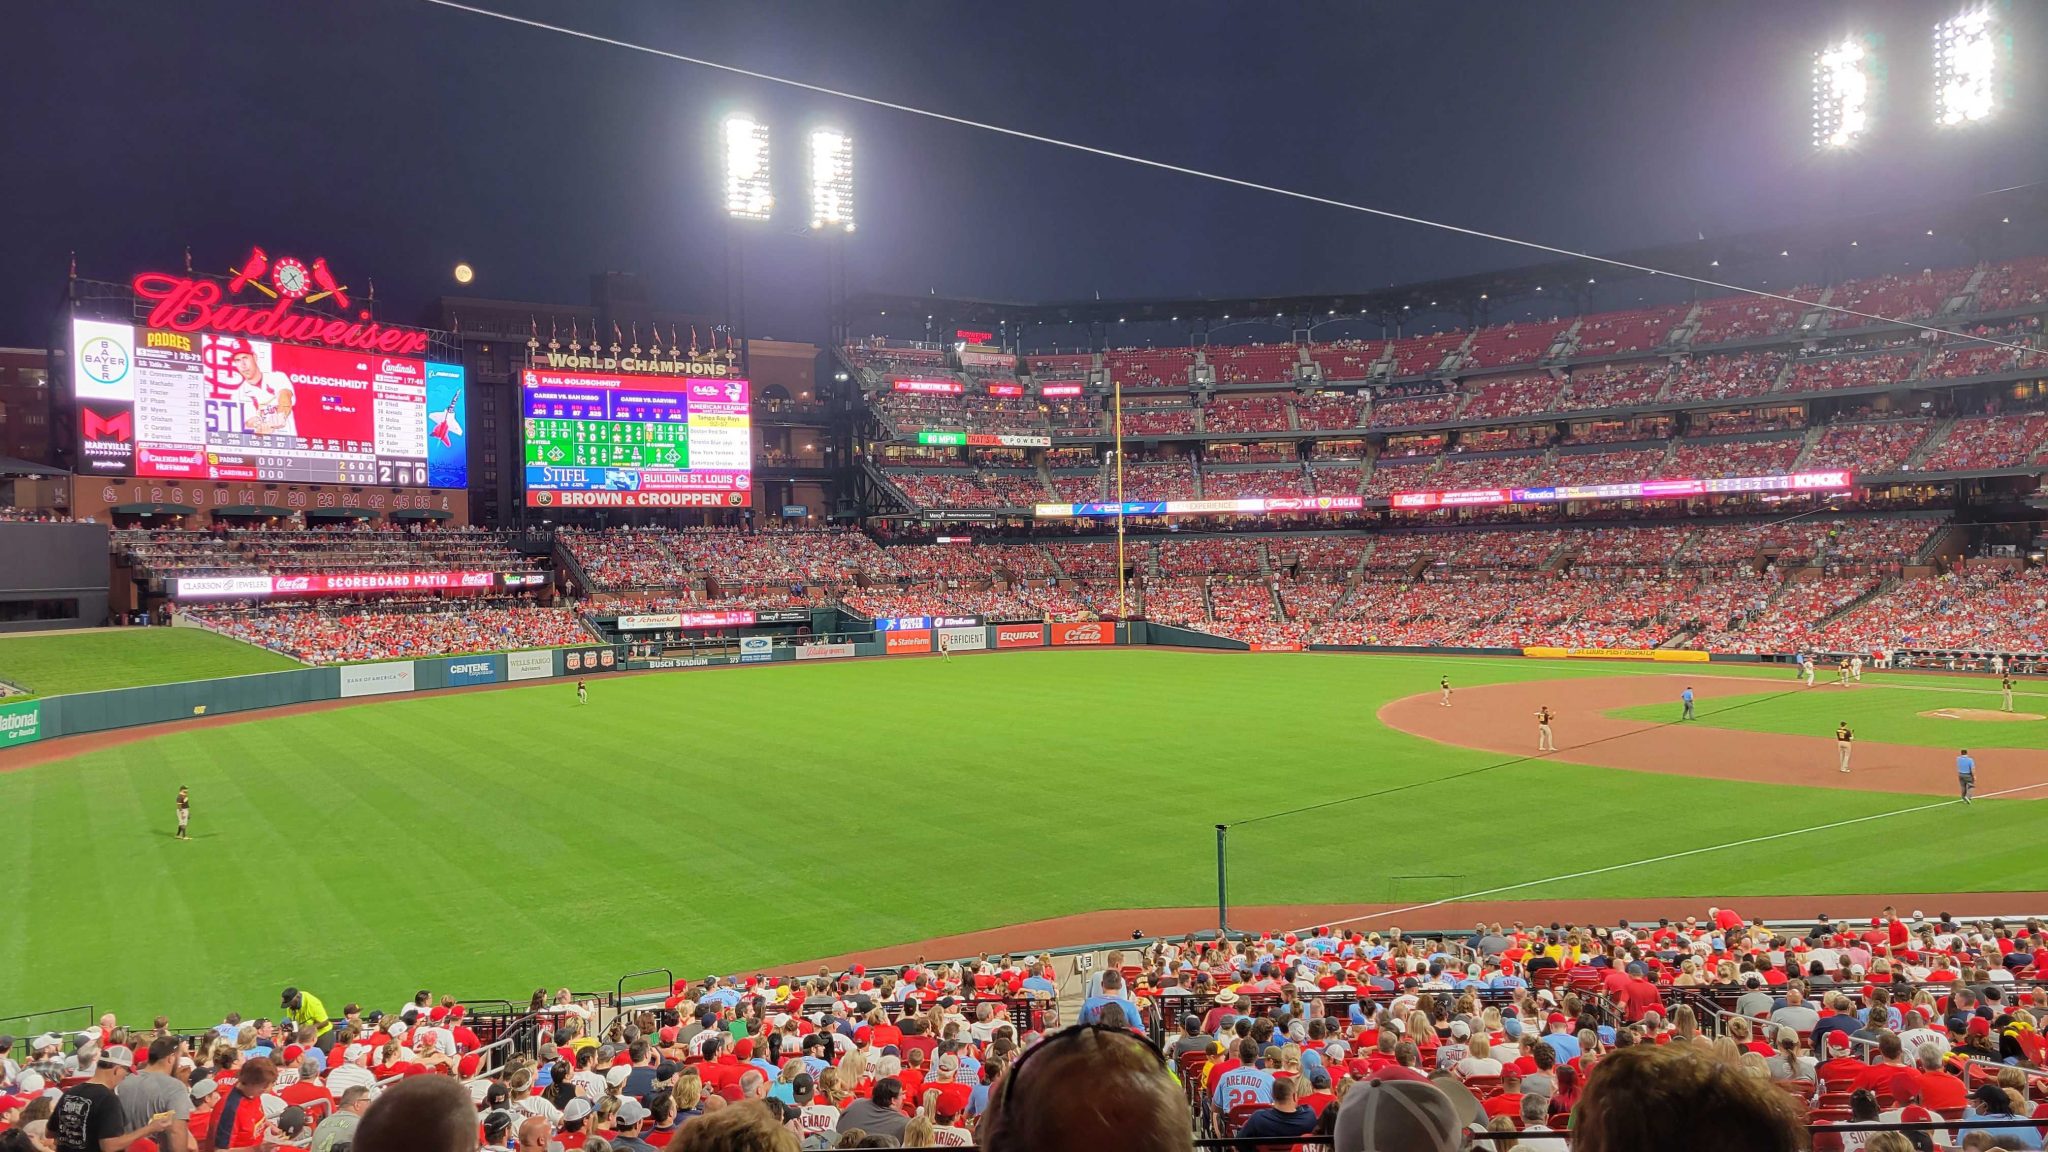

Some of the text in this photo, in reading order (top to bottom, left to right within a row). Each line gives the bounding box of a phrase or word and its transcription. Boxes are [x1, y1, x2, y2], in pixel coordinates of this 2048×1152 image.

[133, 272, 427, 353] Budweiser
[147, 332, 191, 351] PADRES
[85, 355, 125, 365] BAYER
[101, 341, 109, 380] BAYER
[547, 353, 727, 376] WORLD CHAMPIONS
[382, 359, 416, 374] Cardinals
[290, 374, 369, 389] GOLDSCHMIDT
[542, 377, 621, 387] PAUL GOLDSCHMIDT
[205, 400, 255, 434] STL
[625, 424, 631, 433] 3
[625, 434, 632, 442] 2
[940, 435, 956, 443] MPH
[968, 435, 991, 443] THAT'S
[84, 441, 132, 451] MARYVILLE
[590, 446, 597, 454] 0
[219, 456, 243, 464] PADRES
[259, 458, 265, 466] 0
[268, 458, 274, 466] 0
[276, 458, 283, 467] 0
[286, 459, 293, 467] 2
[367, 463, 373, 471] 4
[590, 456, 597, 464] 2
[156, 463, 190, 471] HUFFMAN
[259, 470, 265, 479] 0
[268, 470, 274, 479] 0
[277, 470, 284, 479] 0
[339, 474, 345, 482] 0
[350, 474, 355, 482] 1
[358, 474, 364, 482] 0
[367, 474, 373, 482] 0
[380, 467, 426, 483] 2 0
[543, 467, 589, 482] STIFEL
[643, 473, 733, 484] BUILDING ST. LOUIS
[1794, 473, 1844, 487] KMOX
[134, 486, 431, 509] 1 2 6 9 10 14 17 20 23 24 42 45 85
[561, 492, 721, 505] BROWN & CROUPPEN
[1524, 490, 1554, 499] Fanatics
[1333, 498, 1360, 506] LOCAL
[183, 580, 268, 590] CLARKSON JEWELERS
[276, 574, 487, 591] Coca-Cola SCOREBOARD PATIO Coca-Cola
[638, 615, 678, 623] Schnucks
[940, 633, 984, 646] PERFICIENT
[1000, 631, 1040, 642] EQUIFAX
[749, 640, 764, 648] Ford
[807, 647, 828, 656] Bally
[450, 662, 490, 674] CENTENE
[649, 658, 708, 668] BUSCH STADIUM
[9, 728, 36, 739] Car Rental
[1226, 1075, 1263, 1089] ARENADO
